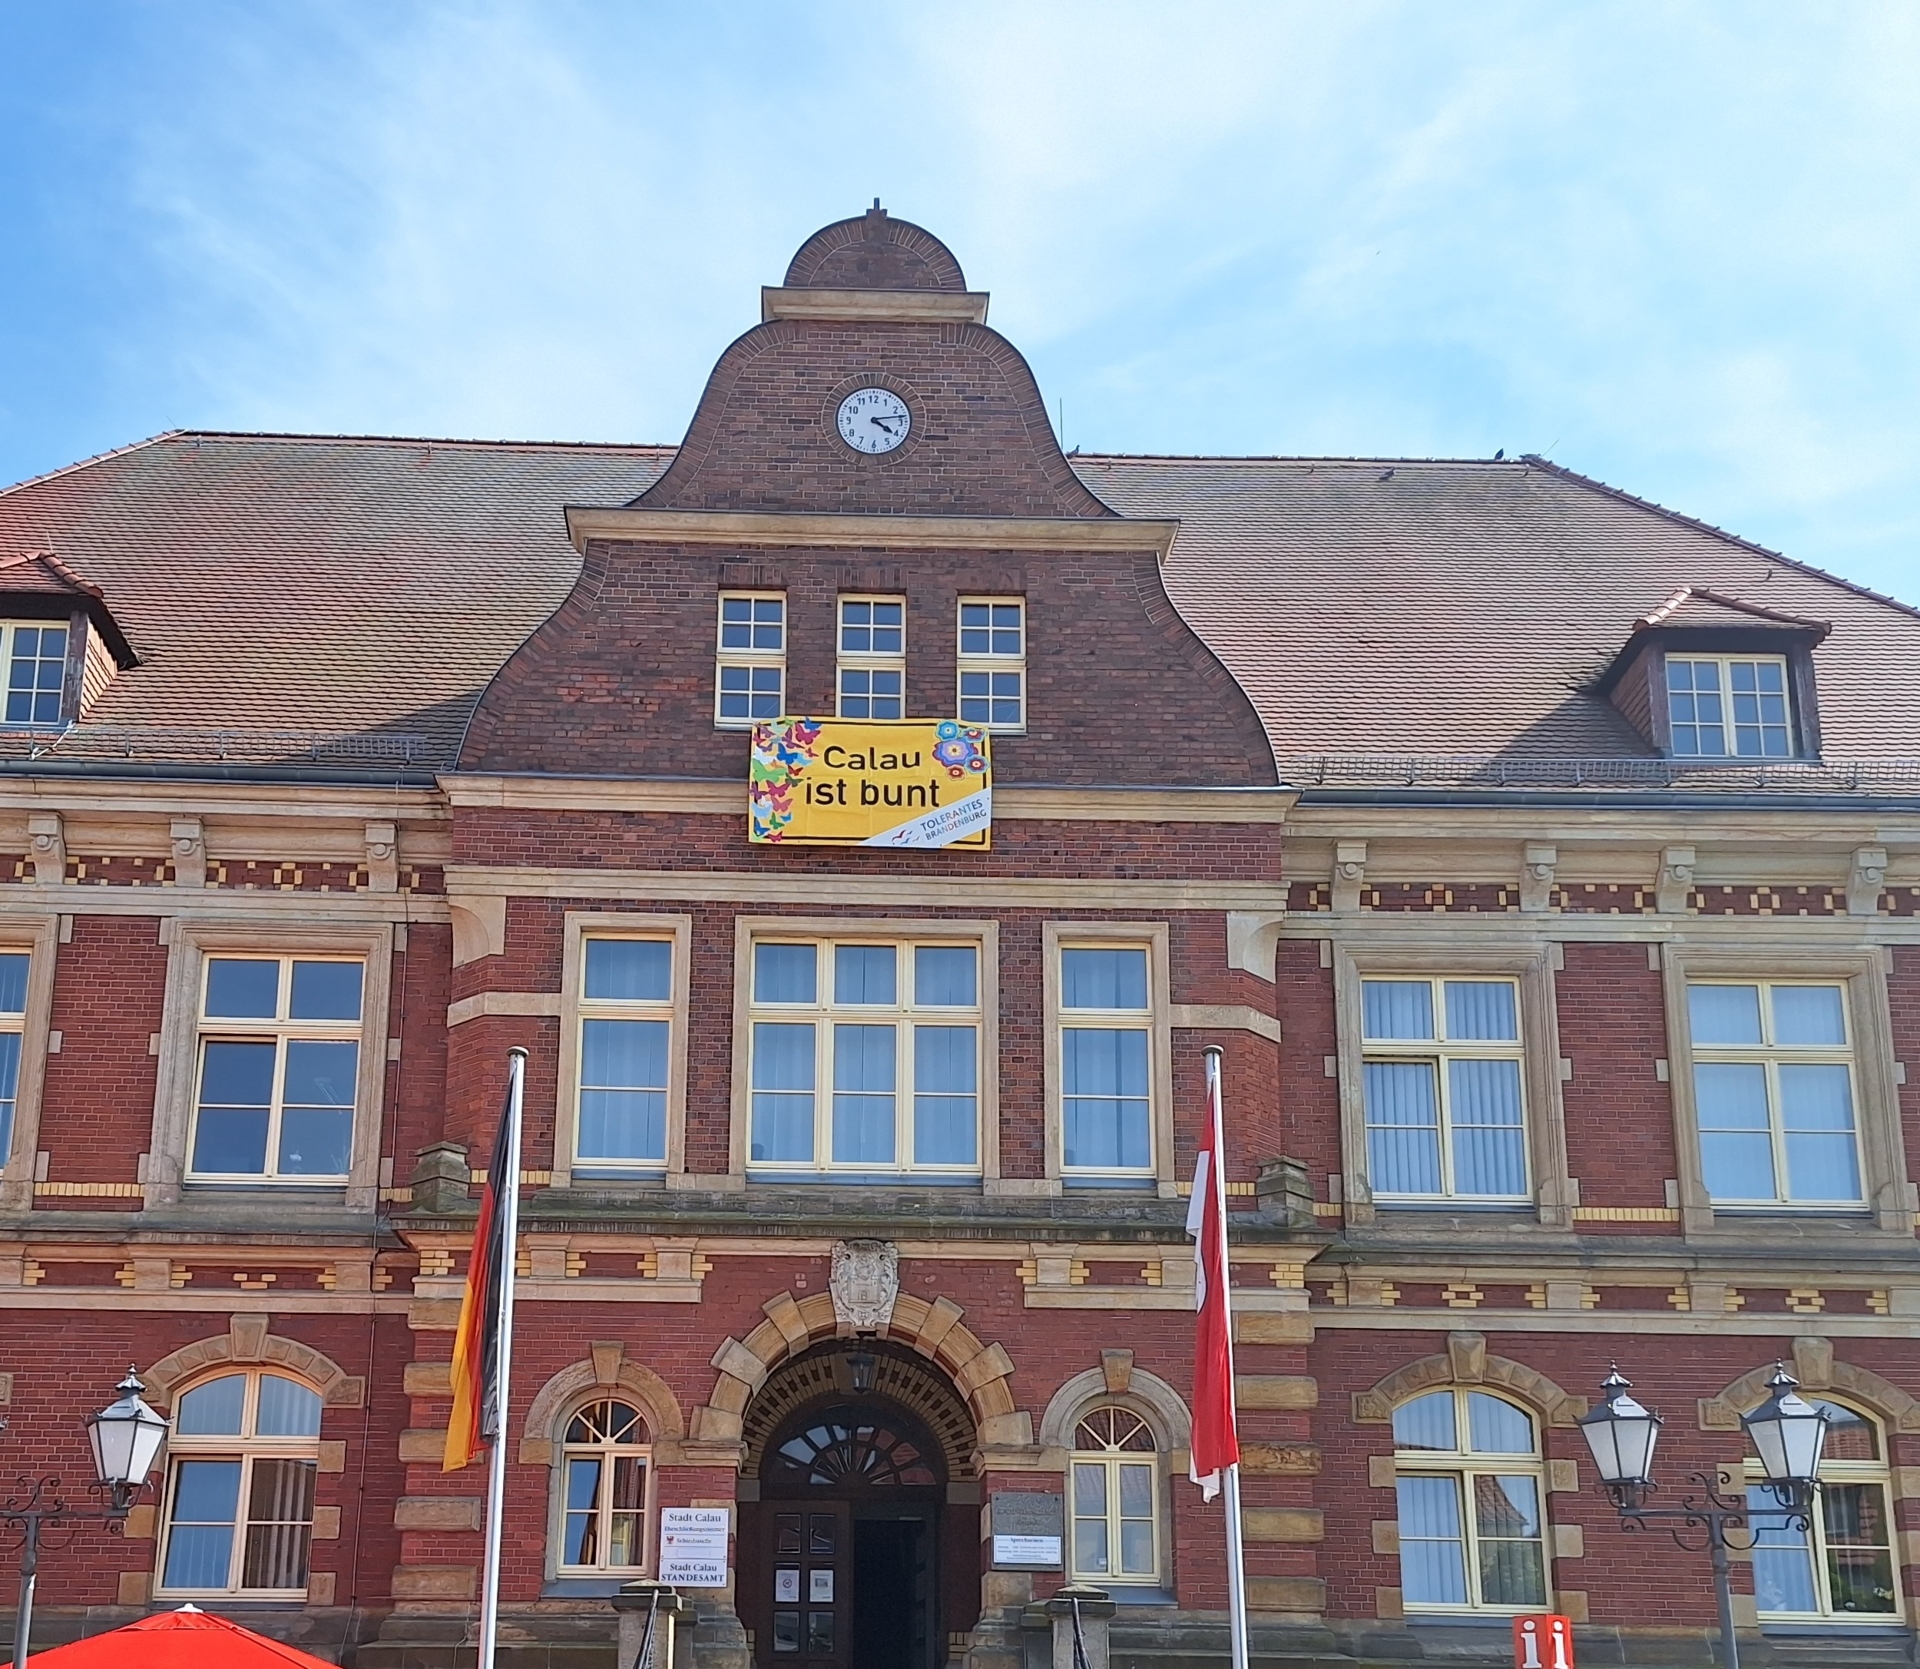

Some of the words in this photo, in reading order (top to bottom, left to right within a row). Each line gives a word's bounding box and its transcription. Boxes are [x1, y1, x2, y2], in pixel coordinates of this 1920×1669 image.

[857, 397, 866, 406] 11
[869, 395, 879, 404] 12
[848, 406, 858, 414] 10
[892, 406, 898, 414] 2
[846, 416, 852, 425] 9
[849, 428, 854, 437] 8
[894, 429, 899, 437] 4
[858, 436, 864, 444] 7
[872, 440, 876, 449] 6
[884, 438, 890, 446] 5
[823, 745, 921, 770] Calau
[805, 776, 847, 806] ist
[860, 779, 940, 808] bunt
[920, 798, 984, 832] TOLERANTES
[925, 809, 987, 841] BRANDENBURG
[668, 1513, 692, 1522] Stadt
[694, 1514, 721, 1522] Calau
[670, 1563, 692, 1572] Stadt
[694, 1564, 717, 1572] Calau
[662, 1574, 724, 1582] STANDESAMT
[1520, 1620, 1542, 1668] i
